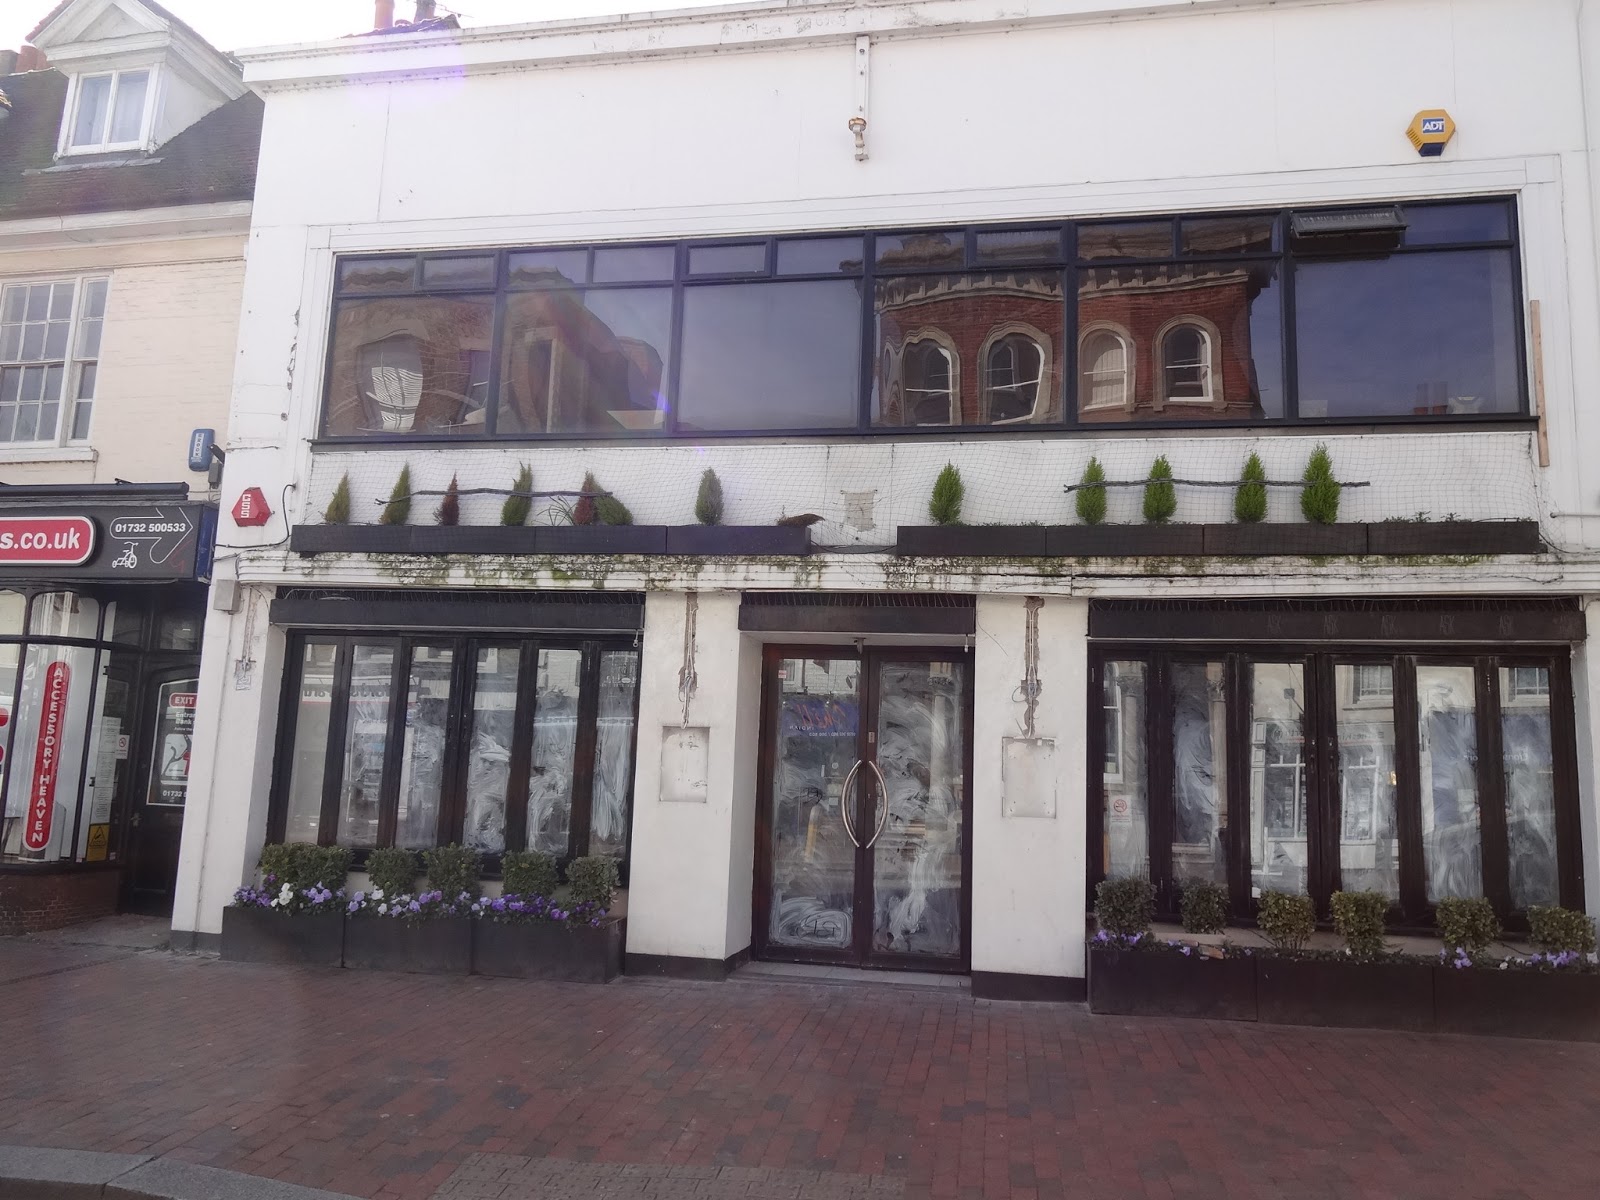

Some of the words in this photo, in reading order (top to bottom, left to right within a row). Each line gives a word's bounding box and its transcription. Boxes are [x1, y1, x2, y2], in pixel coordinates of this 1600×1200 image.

[1423, 121, 1444, 131] ADT
[115, 523, 146, 533] 01732
[149, 523, 186, 532] 500533
[175, 696, 194, 705] EXIT
[43, 667, 63, 769] ACCESSORY
[32, 774, 50, 842] HEAVEN
